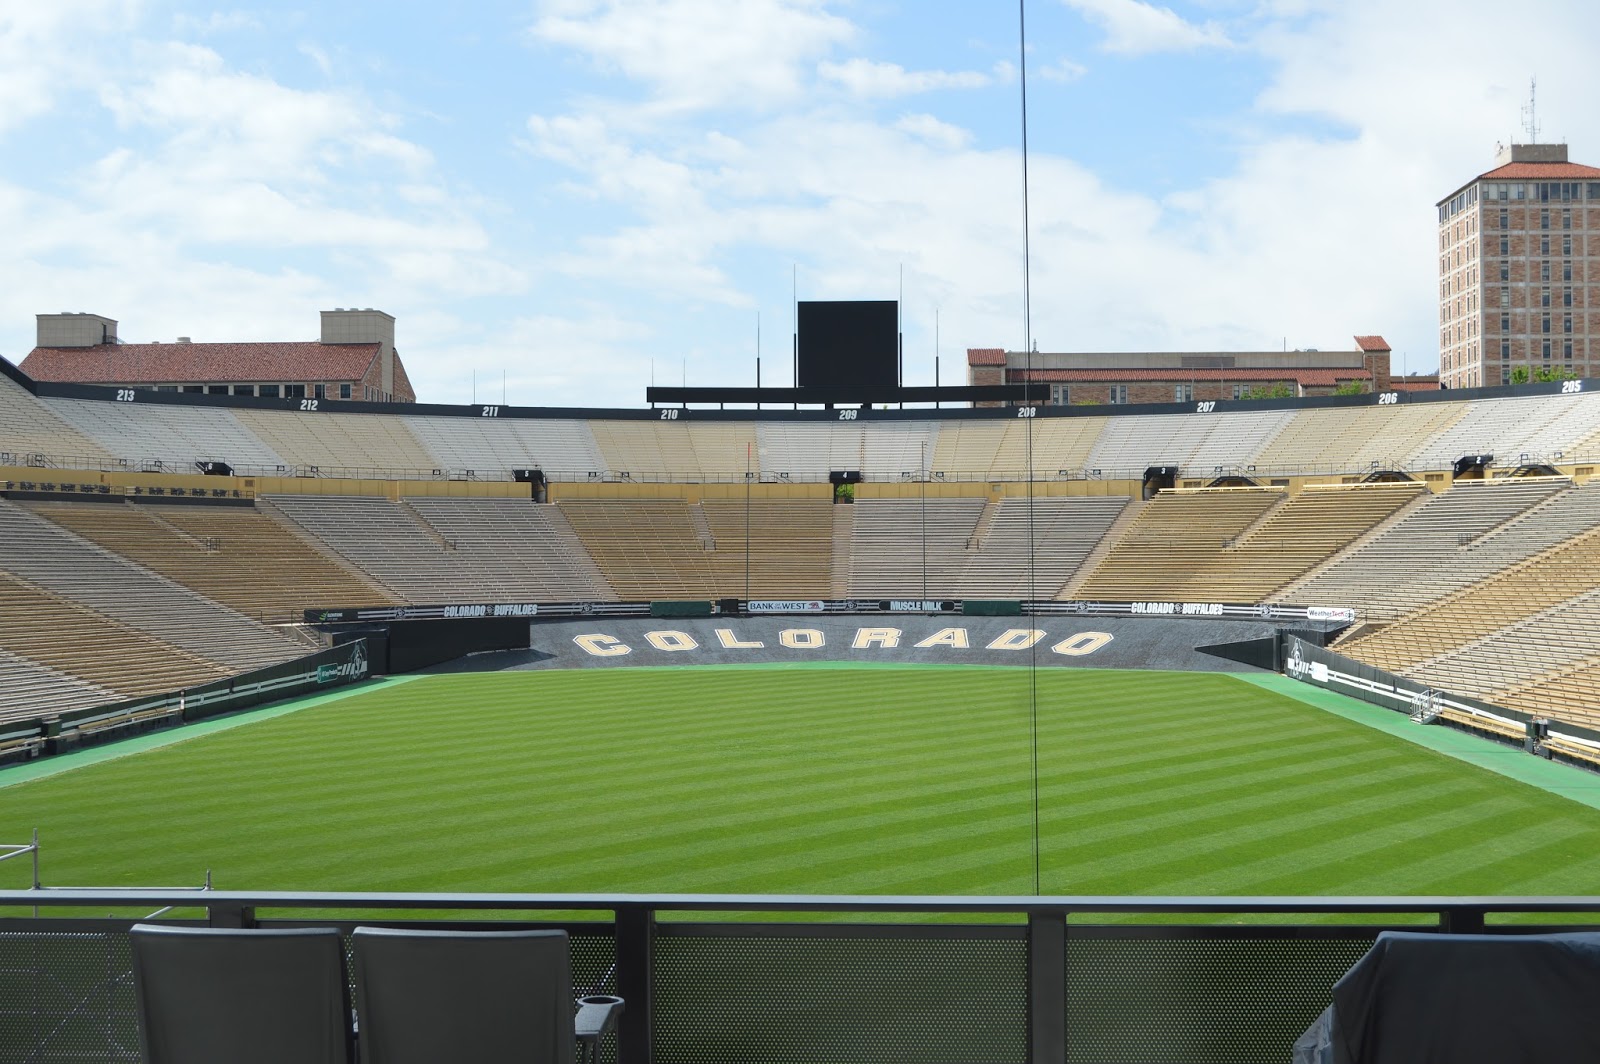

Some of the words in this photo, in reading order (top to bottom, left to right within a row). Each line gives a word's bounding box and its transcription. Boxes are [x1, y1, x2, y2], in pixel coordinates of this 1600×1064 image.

[1561, 380, 1582, 393] 205
[116, 389, 136, 402] 213
[1378, 392, 1399, 405] 206
[299, 399, 319, 411] 212
[1196, 401, 1216, 413] 207
[481, 406, 499, 418] 211
[660, 409, 679, 420] 210
[838, 409, 858, 420] 209
[1017, 407, 1037, 418] 208
[1475, 456, 1481, 464] 2
[524, 470, 530, 478] 5
[842, 471, 848, 479] 4
[1160, 467, 1166, 475] 3
[443, 605, 486, 617] COLORADO
[493, 604, 538, 615] BUFFALOES
[750, 602, 774, 610] BANK
[781, 602, 807, 610] WEST
[890, 601, 921, 611] MUSCLE
[922, 601, 942, 611] MILK
[1130, 602, 1175, 613] COLORADO
[1182, 603, 1224, 615] BUFFALOES
[572, 627, 1115, 657] COLORADO
